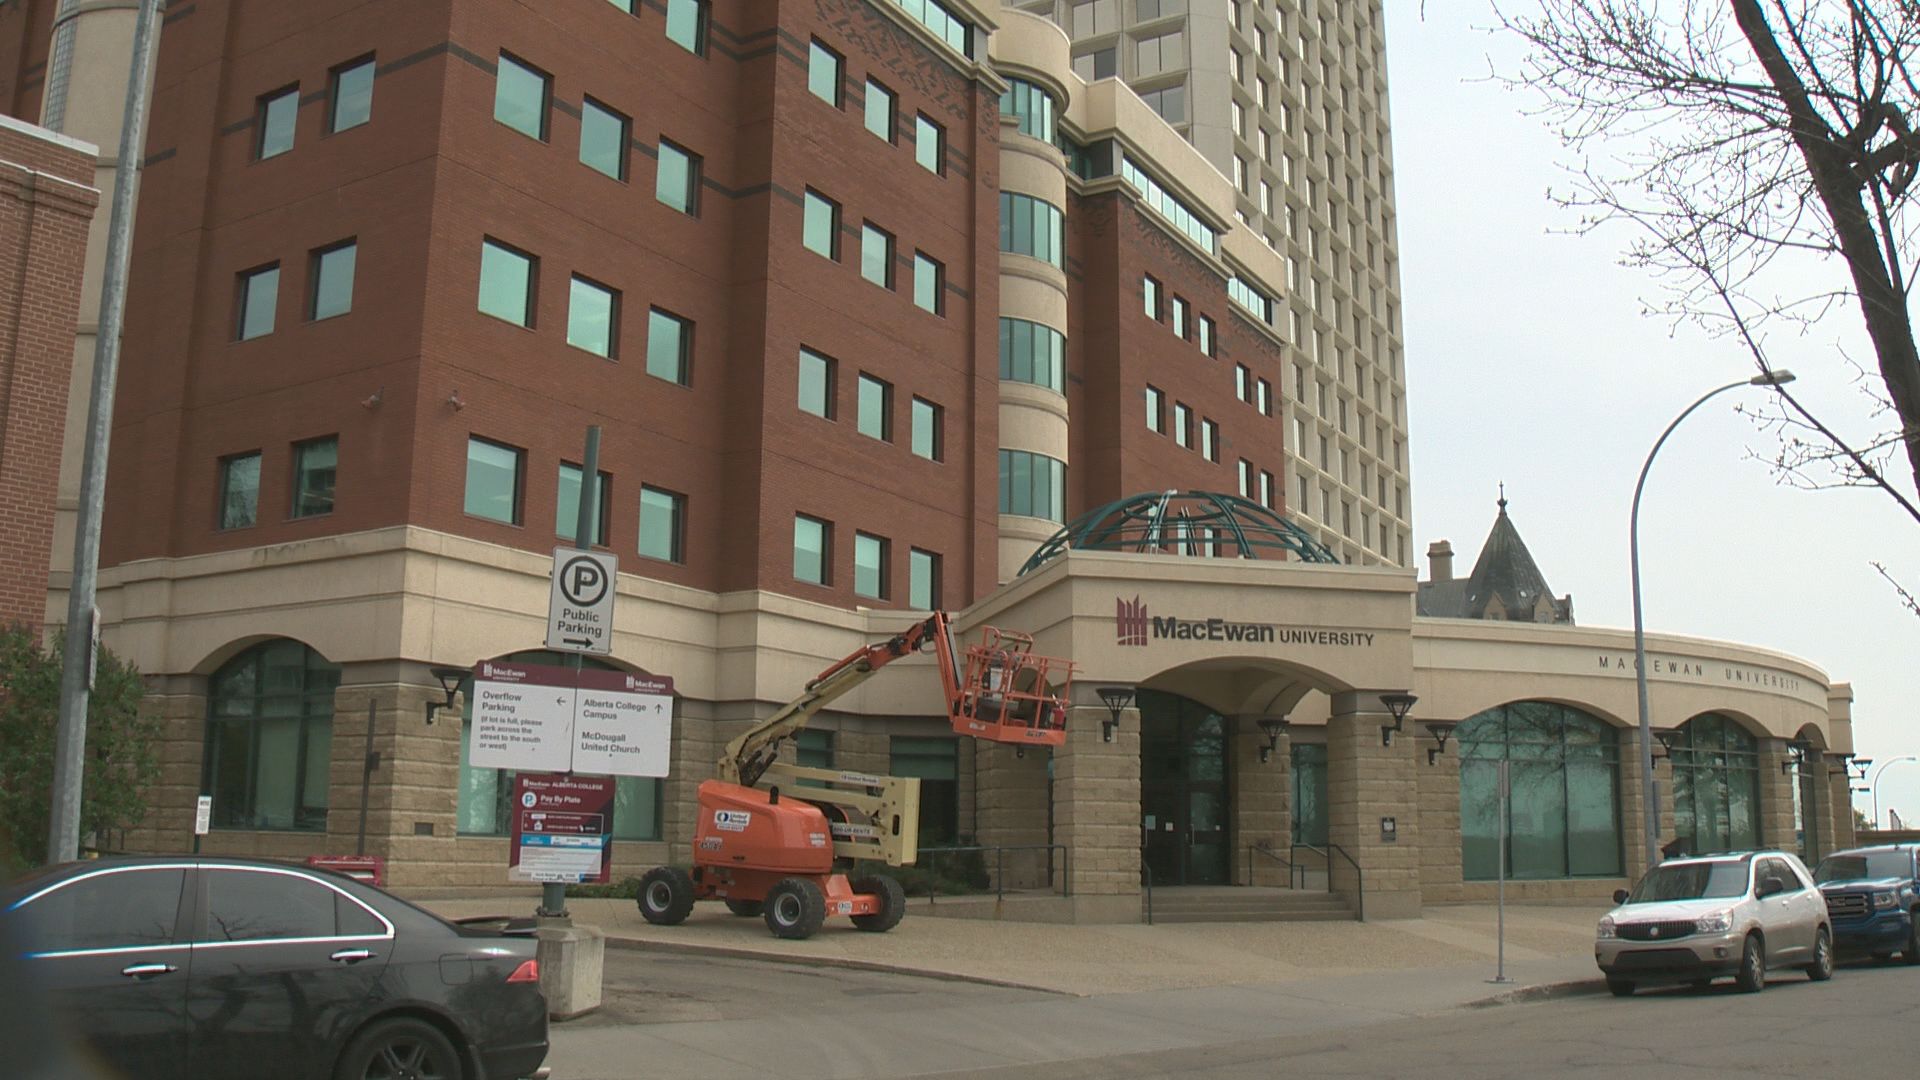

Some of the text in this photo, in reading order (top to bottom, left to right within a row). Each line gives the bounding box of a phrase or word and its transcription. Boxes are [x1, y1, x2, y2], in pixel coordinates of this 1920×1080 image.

[563, 608, 600, 622] Public
[557, 621, 602, 638] Parking
[1153, 616, 1374, 646] MacEwan UNIVERSITY
[493, 668, 526, 678] MacEwan
[635, 680, 666, 689] MacEwan
[1725, 668, 1799, 691] UNIVERSITY
[483, 691, 522, 701] Overflow
[482, 702, 515, 713] Parking
[583, 699, 647, 712] Alberta College
[583, 709, 617, 720] Campus
[520, 719, 542, 727] please
[510, 734, 521, 742] the
[581, 731, 626, 742] McDougall
[581, 742, 640, 753] United Church
[541, 795, 553, 803] Pay
[564, 796, 581, 804] Plate
